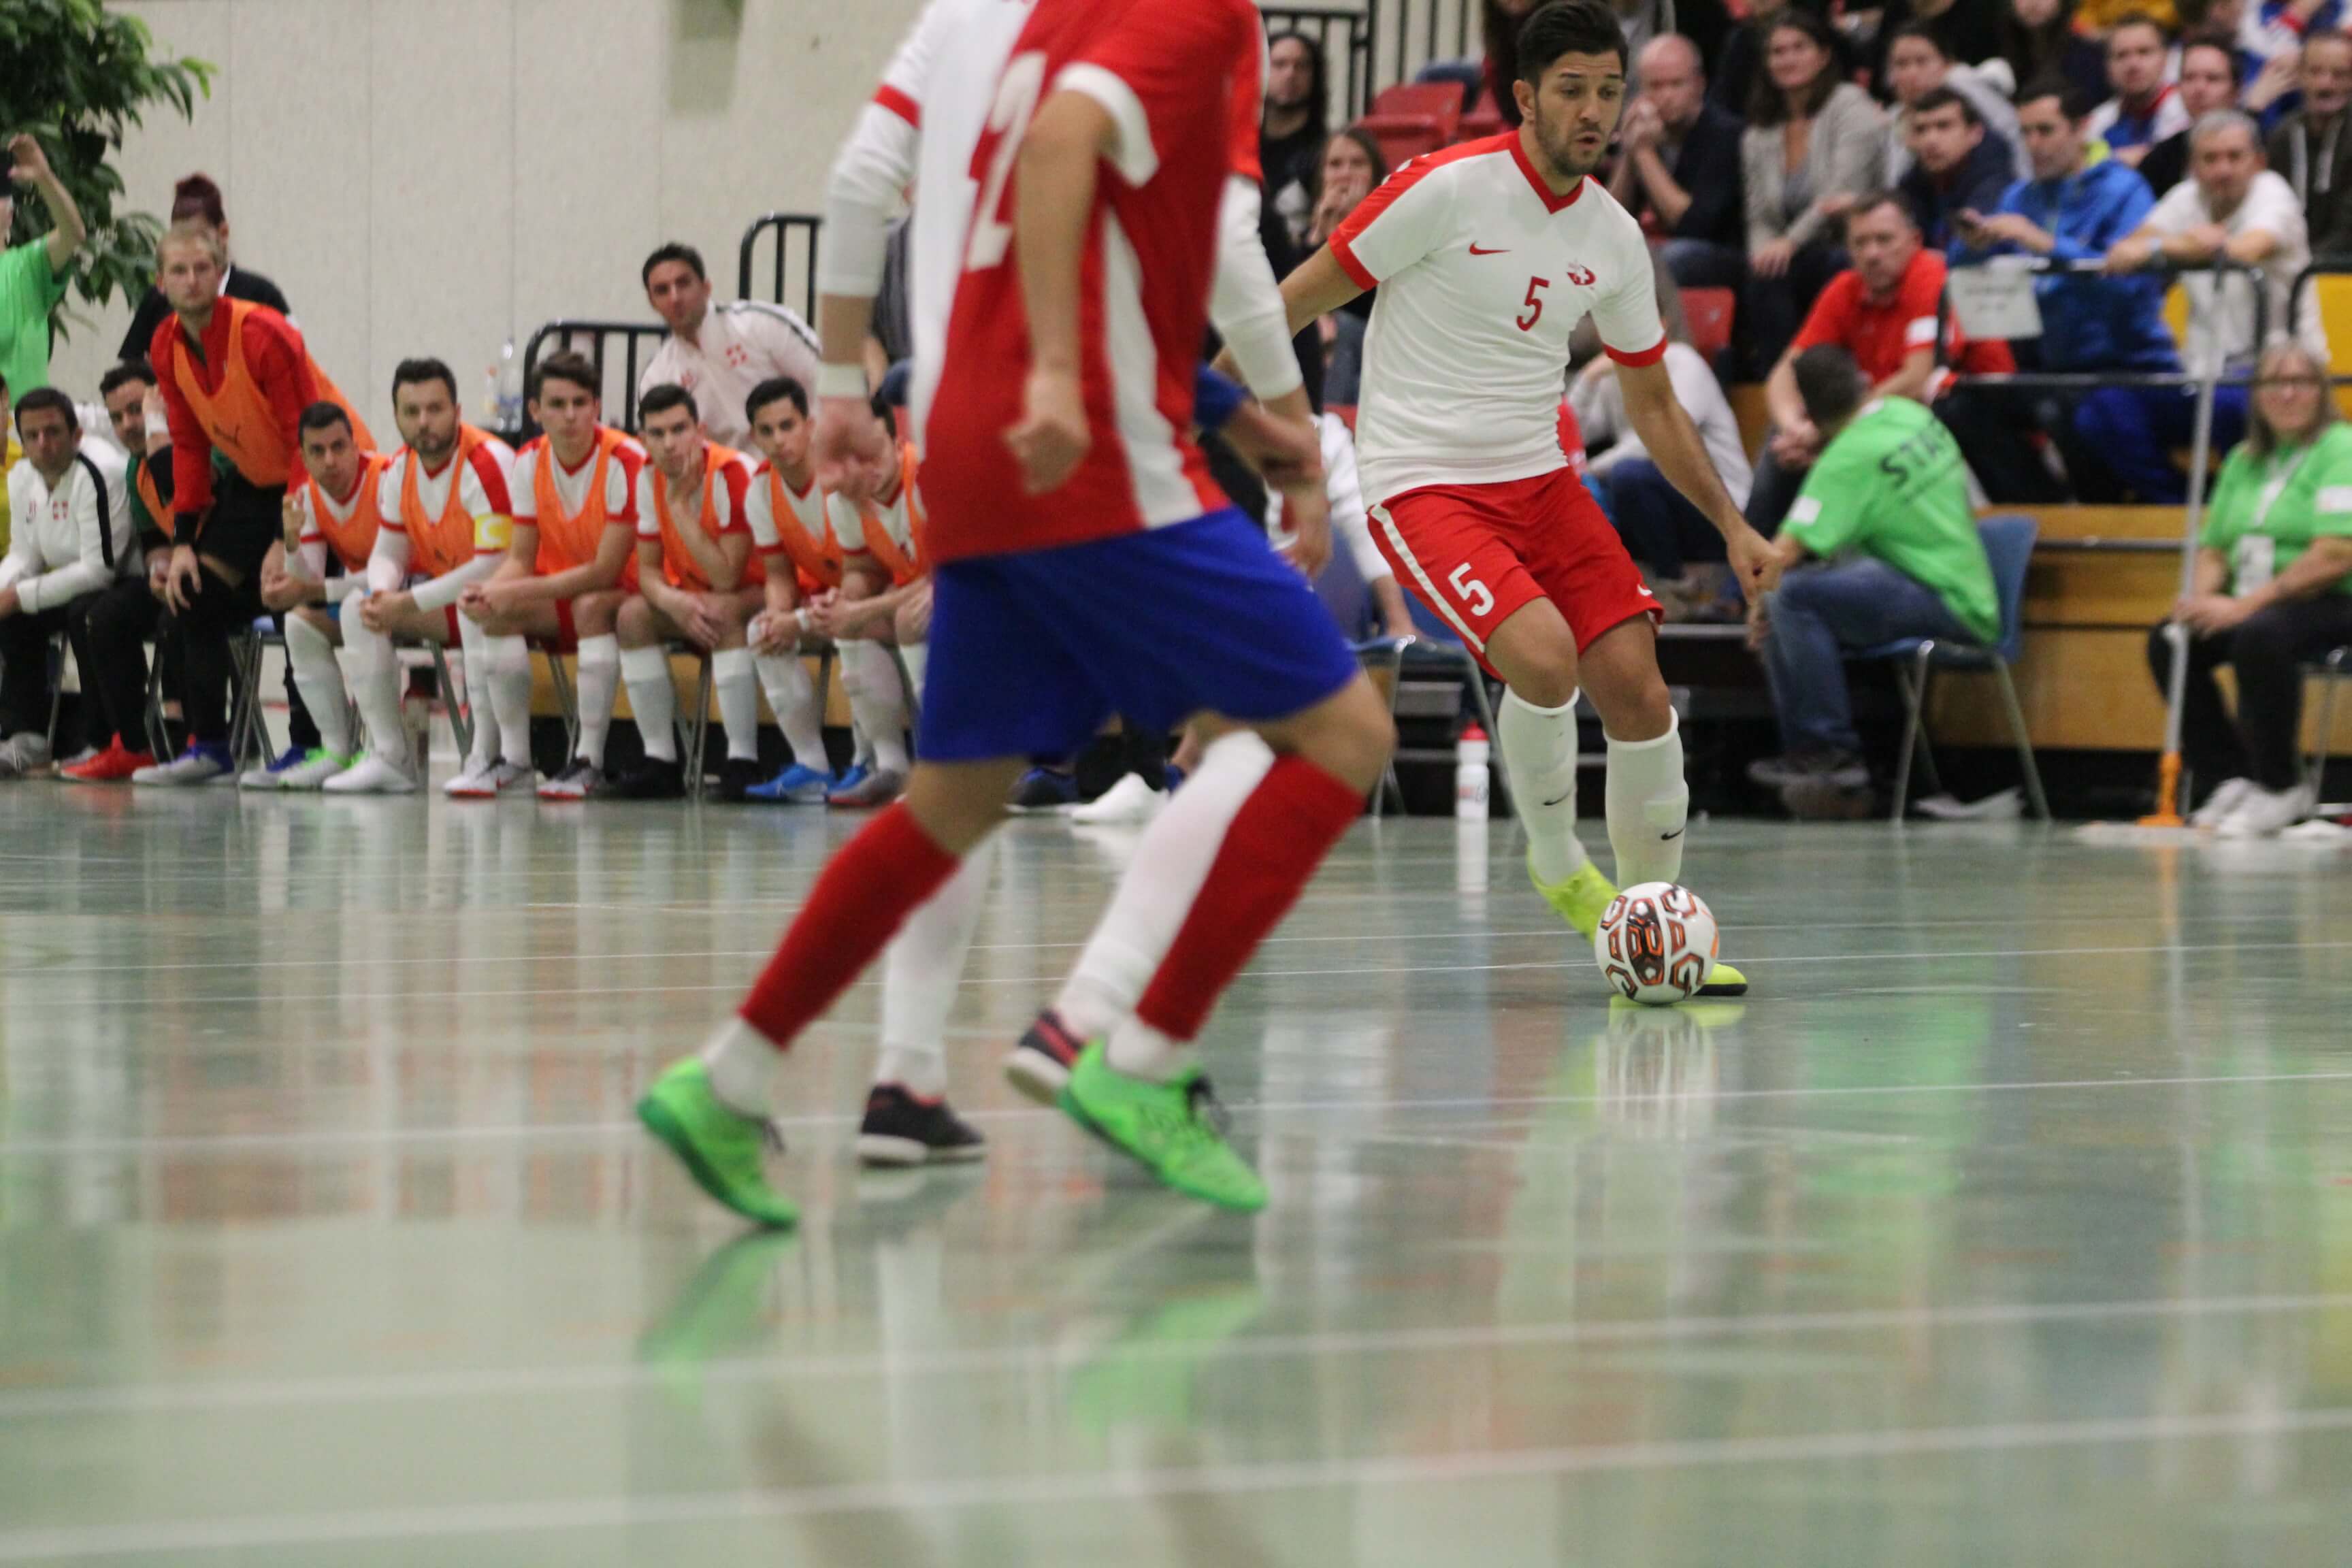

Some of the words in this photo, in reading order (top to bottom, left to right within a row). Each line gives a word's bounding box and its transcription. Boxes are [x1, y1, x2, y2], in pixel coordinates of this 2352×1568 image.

[1516, 275, 1550, 331] 5
[480, 517, 503, 545] C
[1448, 562, 1494, 617] 5
